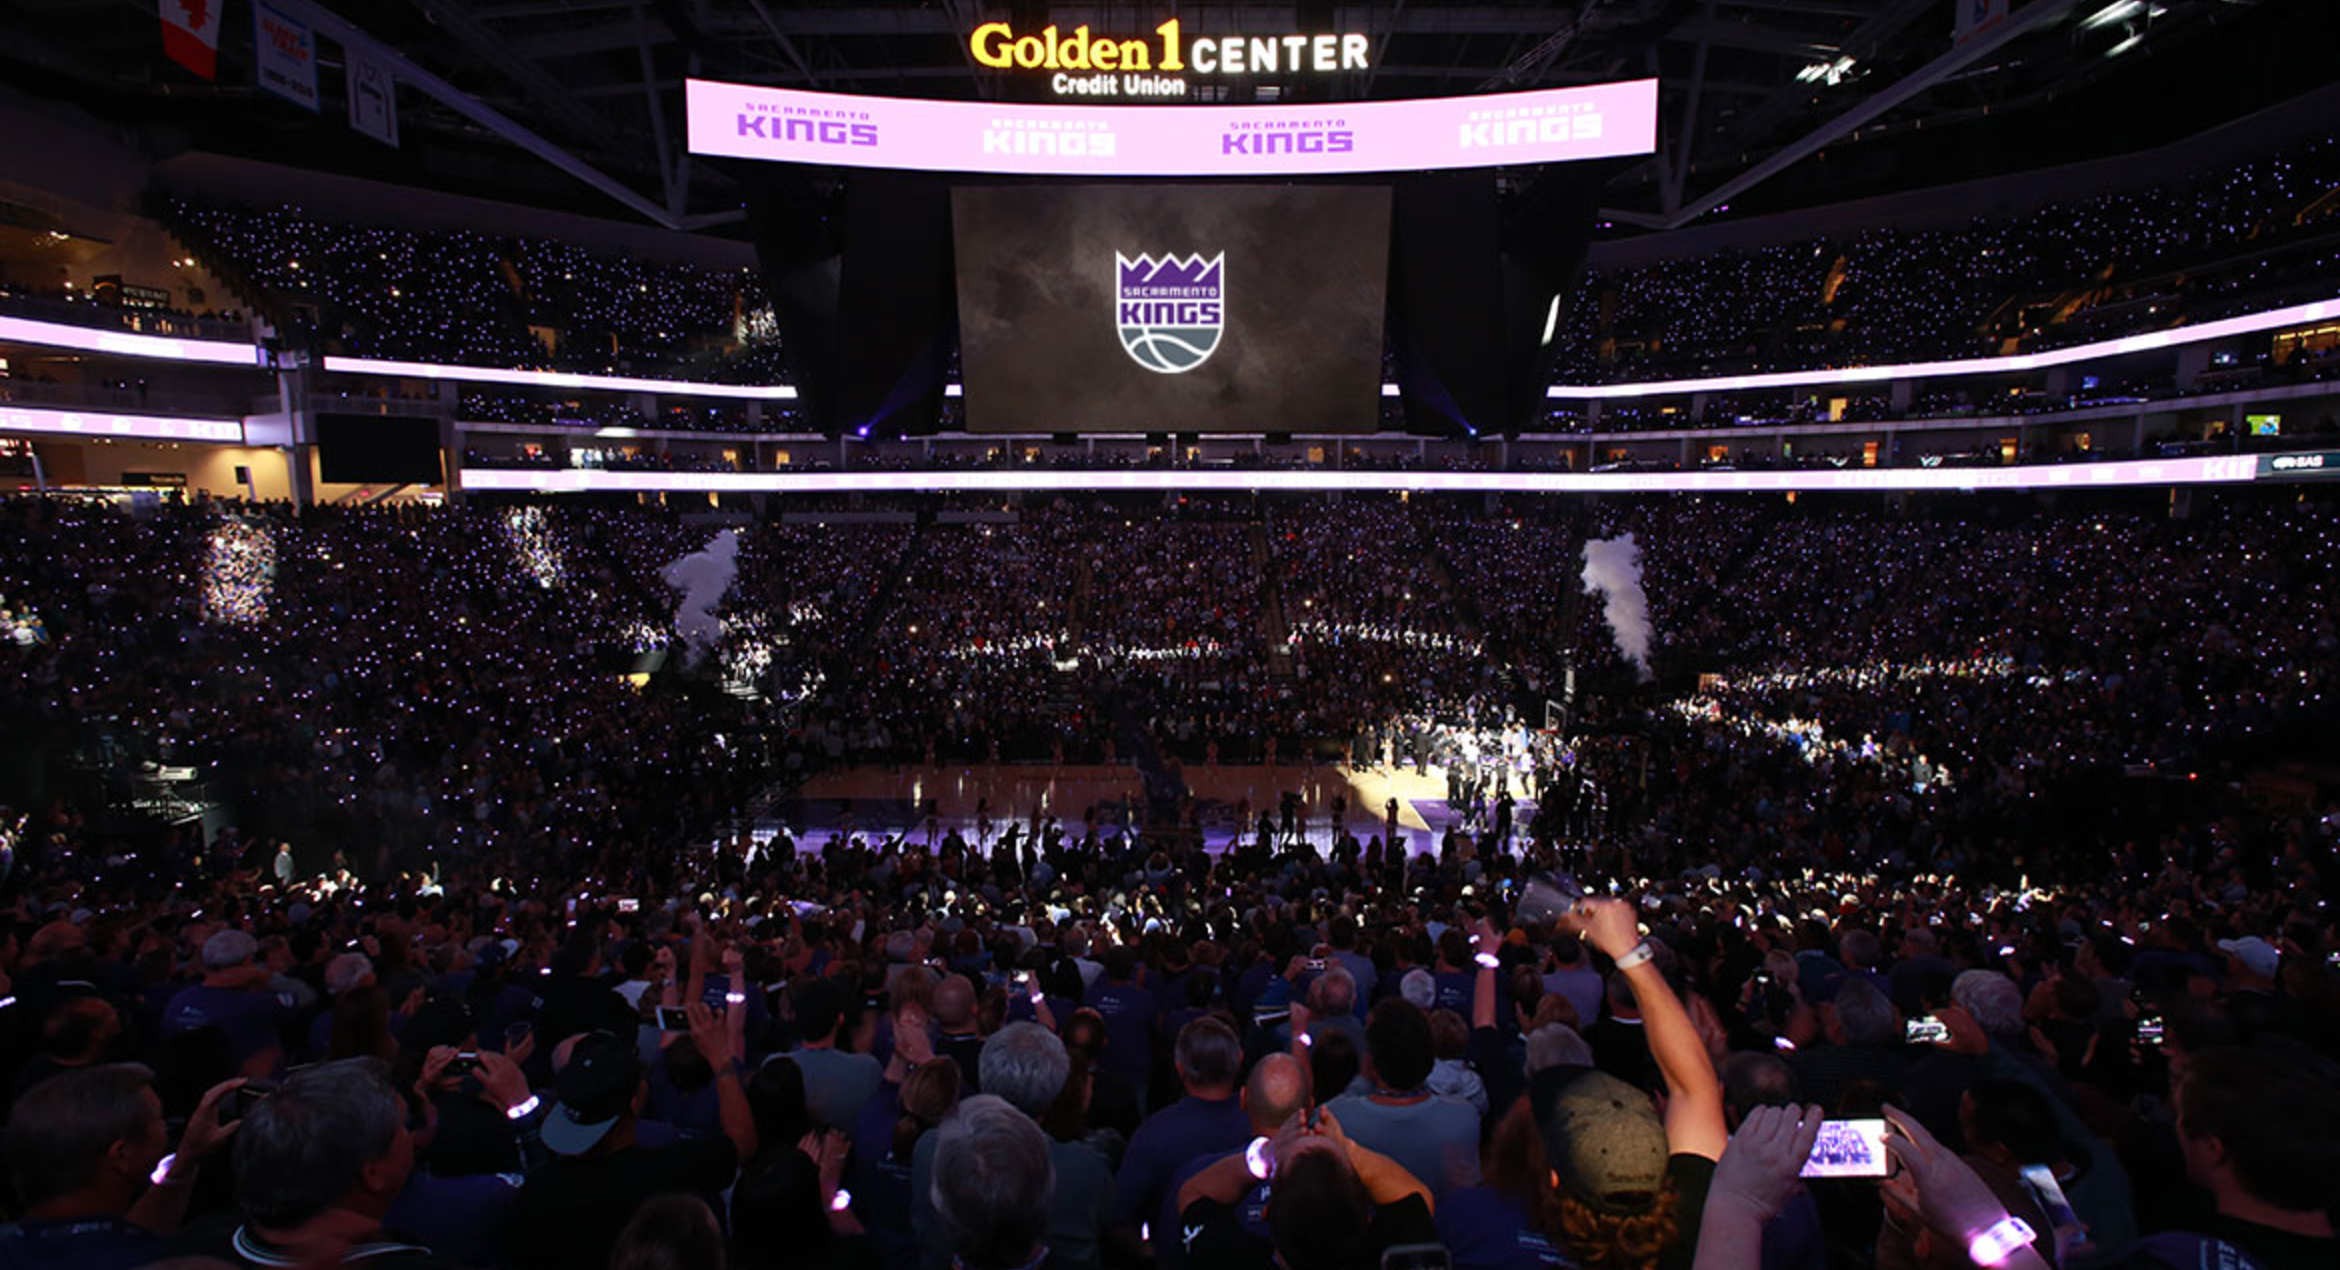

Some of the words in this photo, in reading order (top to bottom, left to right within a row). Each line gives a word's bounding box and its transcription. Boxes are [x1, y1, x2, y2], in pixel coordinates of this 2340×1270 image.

[970, 22, 1152, 70] Golden
[1155, 18, 1185, 71] 1
[1191, 34, 1369, 73] CENTER
[1052, 73, 1118, 95] Credit
[1123, 74, 1186, 96] Union
[745, 103, 870, 121] SACRAMENTO
[1229, 118, 1347, 130] SACRAMENTO
[736, 112, 879, 147] KINGS
[1459, 112, 1603, 149] KINGS
[983, 129, 1117, 156] KINGS
[1221, 130, 1355, 155] KINGS
[1123, 286, 1217, 297] SACRAMENTO
[1120, 302, 1220, 325] KINGS
